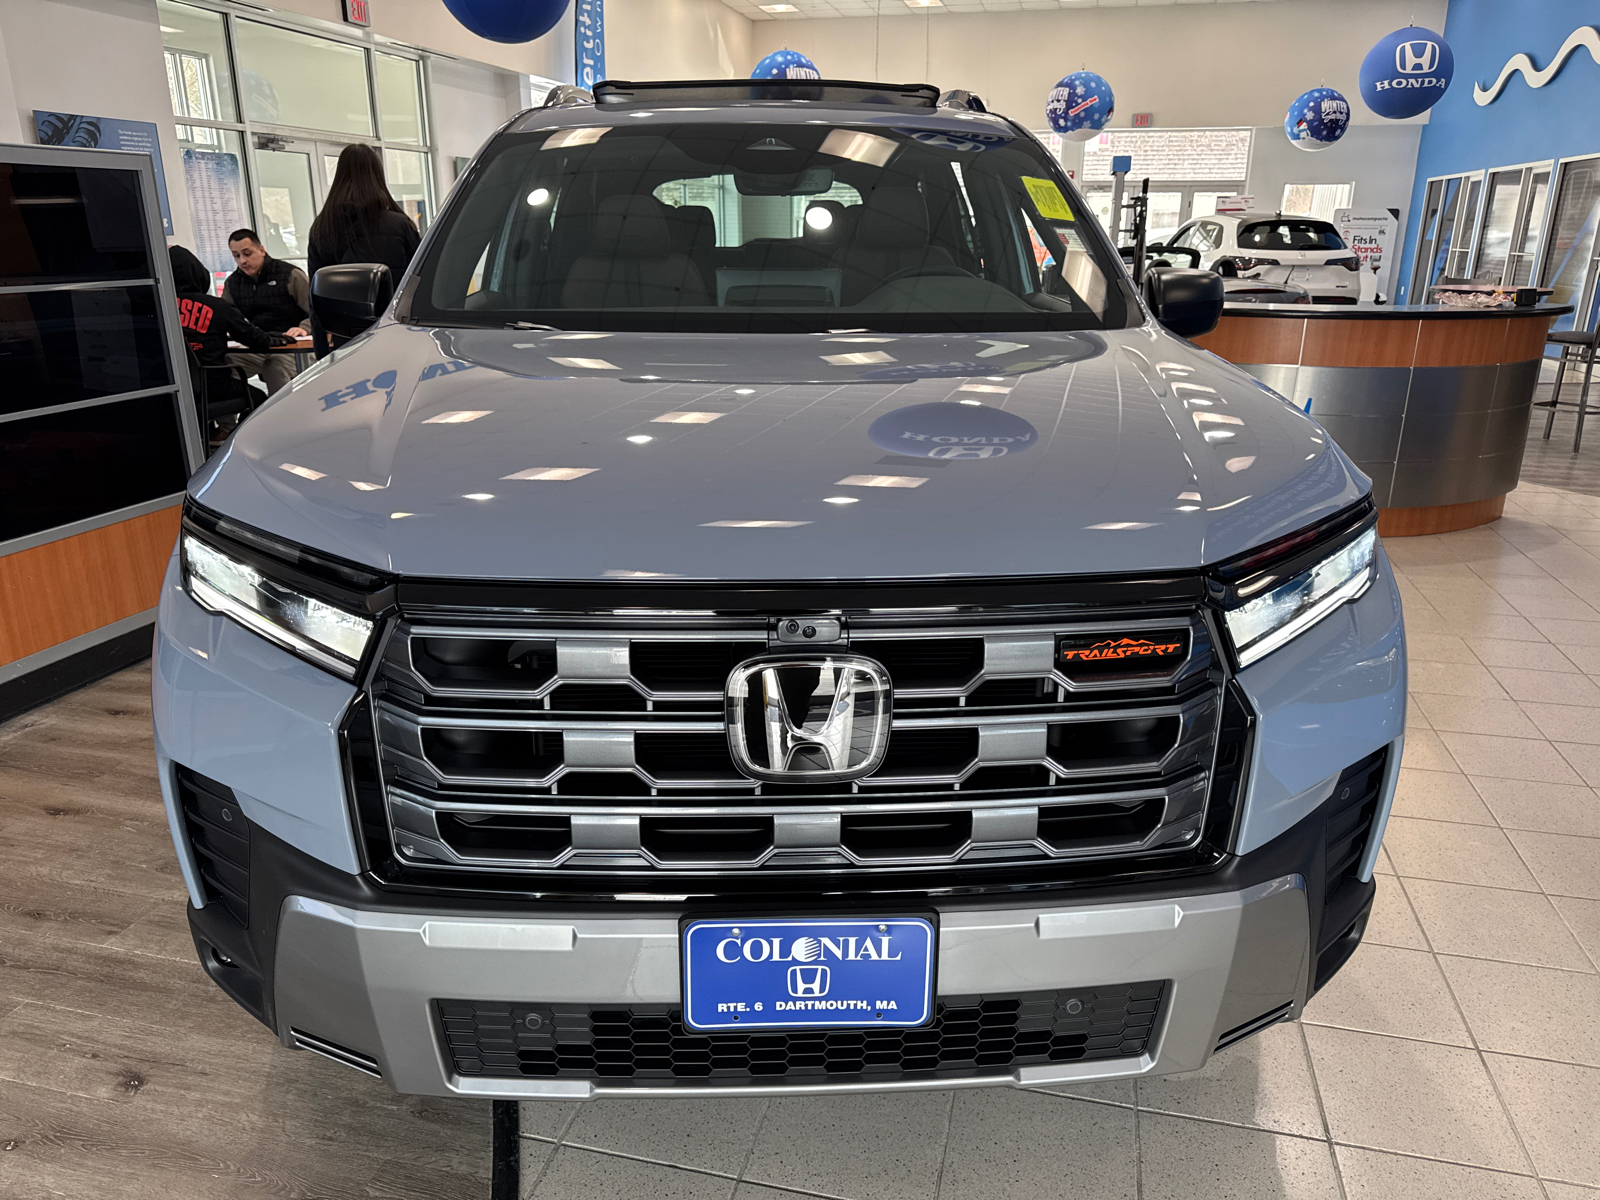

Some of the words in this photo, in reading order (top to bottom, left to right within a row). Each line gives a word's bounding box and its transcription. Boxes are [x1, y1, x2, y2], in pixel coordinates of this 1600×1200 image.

[351, 0, 367, 23] EXIT
[1375, 77, 1446, 92] HONDA
[1321, 99, 1348, 113] WINTER
[1135, 114, 1149, 126] EXIT
[1353, 235, 1367, 244] Fits
[1368, 235, 1377, 244] In
[1352, 244, 1383, 254] Stands
[176, 297, 214, 334] SED
[1064, 643, 1181, 661] TRAILSPORT
[715, 936, 902, 963] COLONIAL
[717, 1002, 750, 1012] RTE.
[754, 1002, 763, 1011] 6
[775, 1000, 872, 1012] DARTMOUTH,
[875, 1000, 898, 1010] MA
